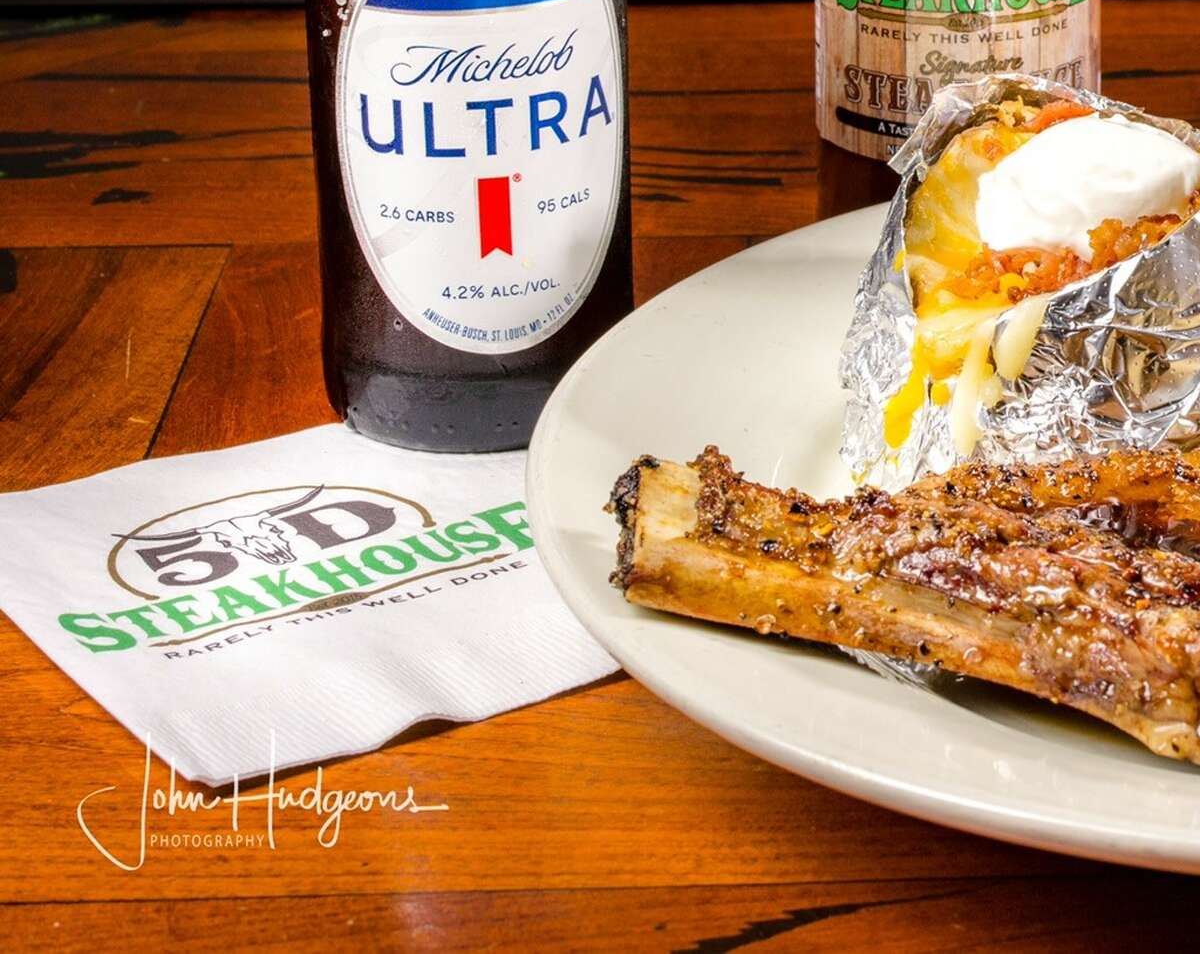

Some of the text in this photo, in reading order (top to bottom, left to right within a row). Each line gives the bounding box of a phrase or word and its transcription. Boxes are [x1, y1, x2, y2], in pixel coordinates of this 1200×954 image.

[390, 28, 579, 86] Michelob
[860, 18, 1069, 44] RARELY THIS WELL DONE
[844, 63, 968, 115] STEA
[919, 49, 1024, 85] Signature
[359, 74, 613, 158] ULTRA
[380, 204, 455, 224] 2.6 CARBS
[537, 188, 591, 215] 95 CALS
[442, 278, 561, 300] 4.2% ALC./VOL.
[135, 500, 397, 587] 5 D
[57, 501, 536, 654] STEAKHOUSE
[163, 559, 528, 660] RARELY THIS WELL DONE
